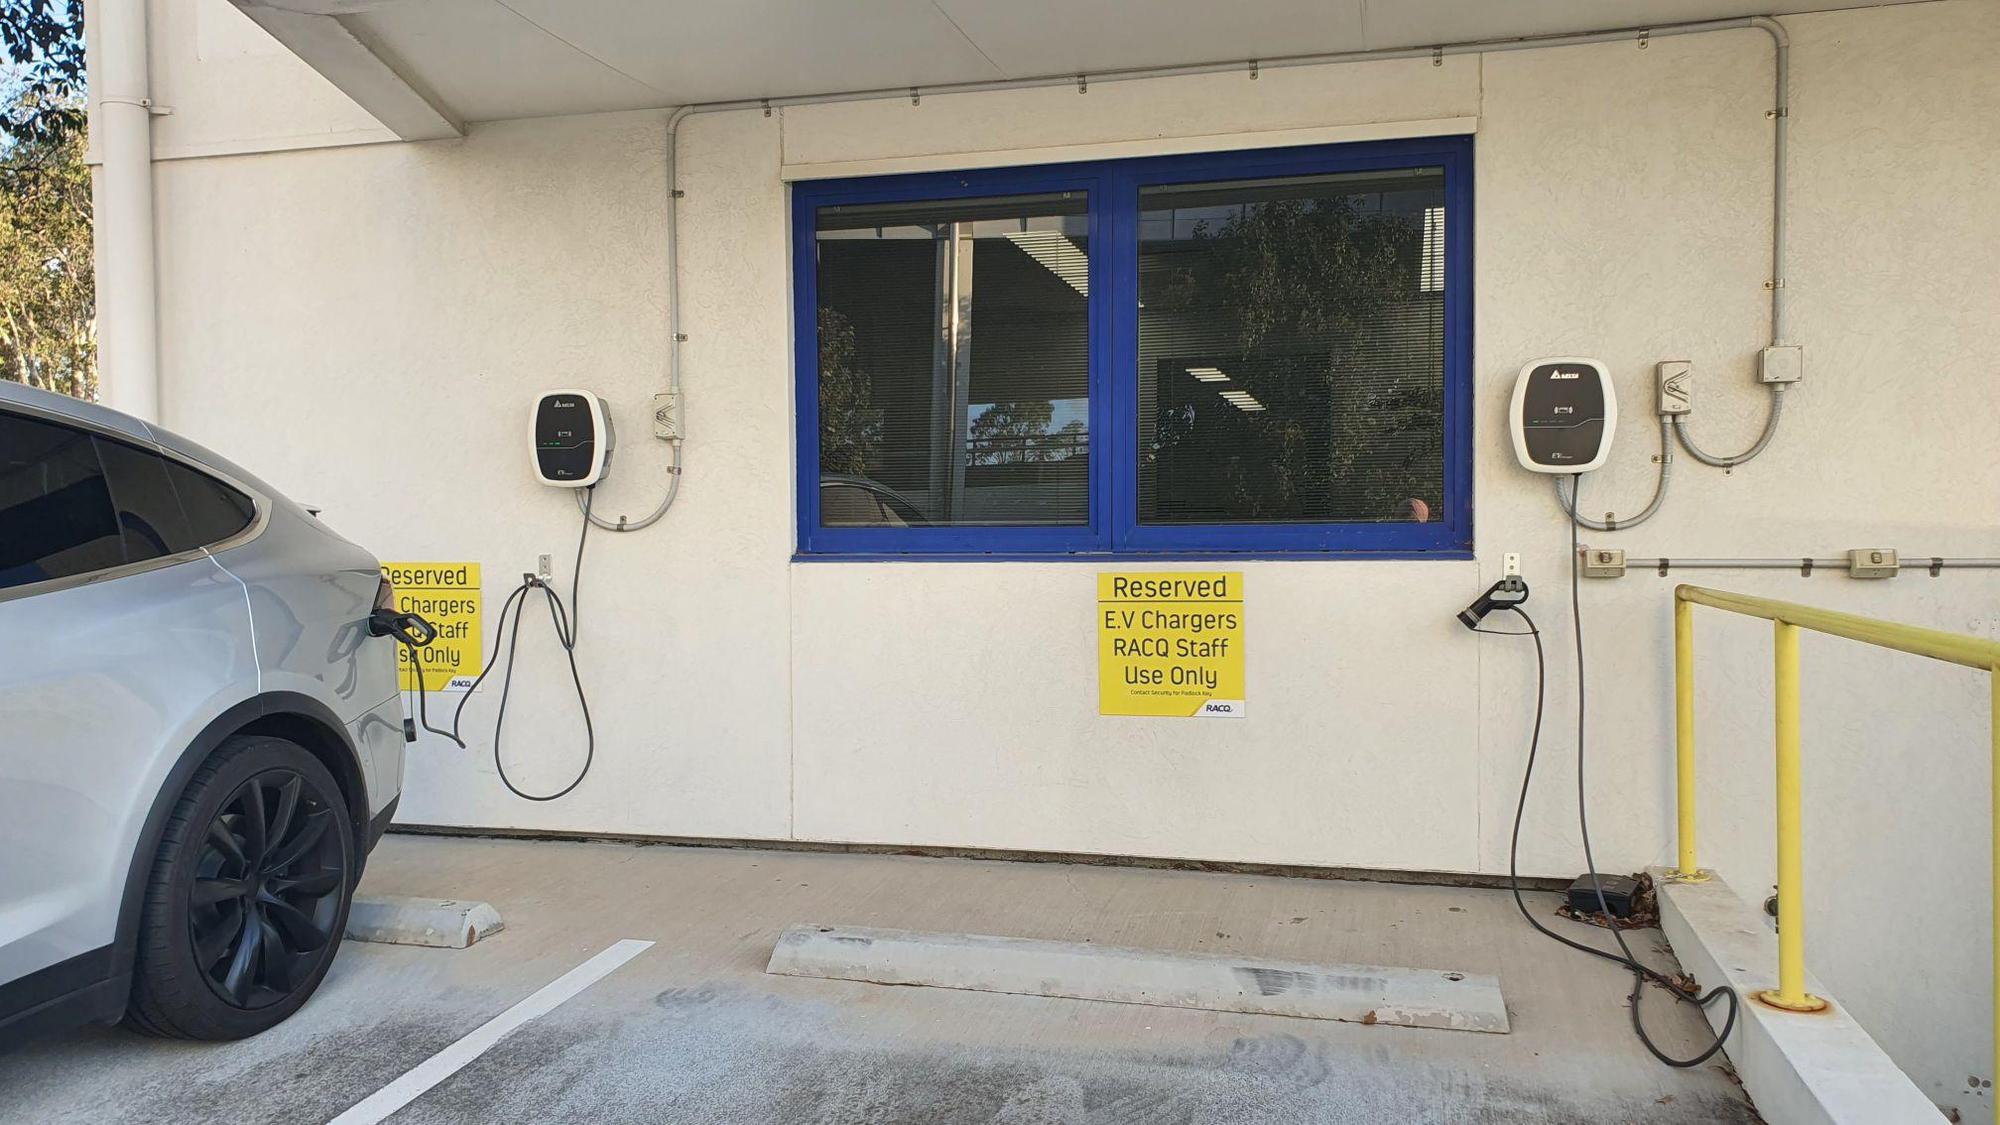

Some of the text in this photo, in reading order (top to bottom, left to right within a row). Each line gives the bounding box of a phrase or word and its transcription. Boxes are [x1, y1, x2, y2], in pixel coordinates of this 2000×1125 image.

[1114, 575, 1226, 598] Reserved
[400, 596, 475, 616] Chargers
[428, 621, 469, 638] taff
[1105, 610, 1237, 632] E.V Chargers
[424, 646, 460, 666] Only
[1114, 638, 1228, 657] RACQ Staff
[1125, 666, 1217, 688] Use Only
[1205, 704, 1232, 712] RACQ
